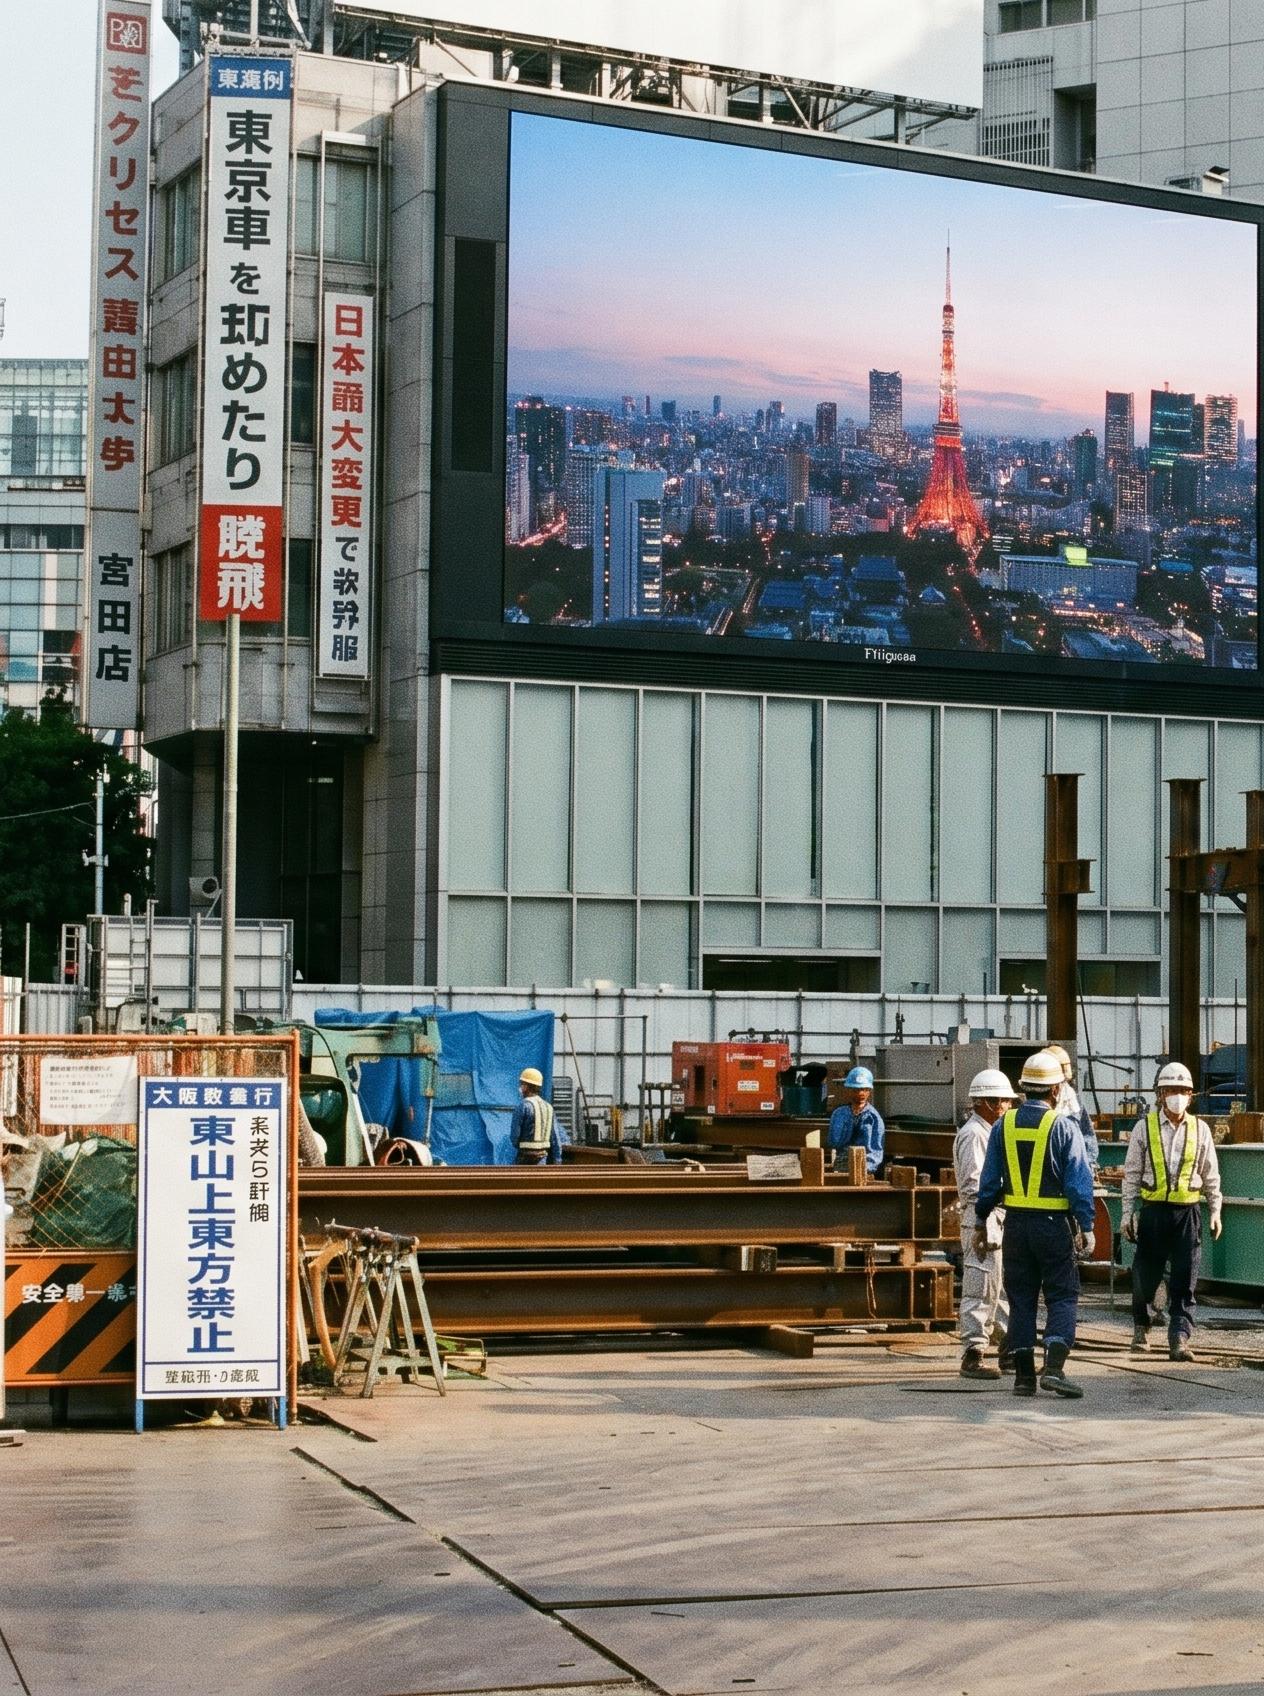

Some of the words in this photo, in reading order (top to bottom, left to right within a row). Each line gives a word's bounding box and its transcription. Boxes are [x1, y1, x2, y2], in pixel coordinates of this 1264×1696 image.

[96, 552, 133, 683] 宮田店
[187, 1115, 236, 1354] 東山上東方禁止
